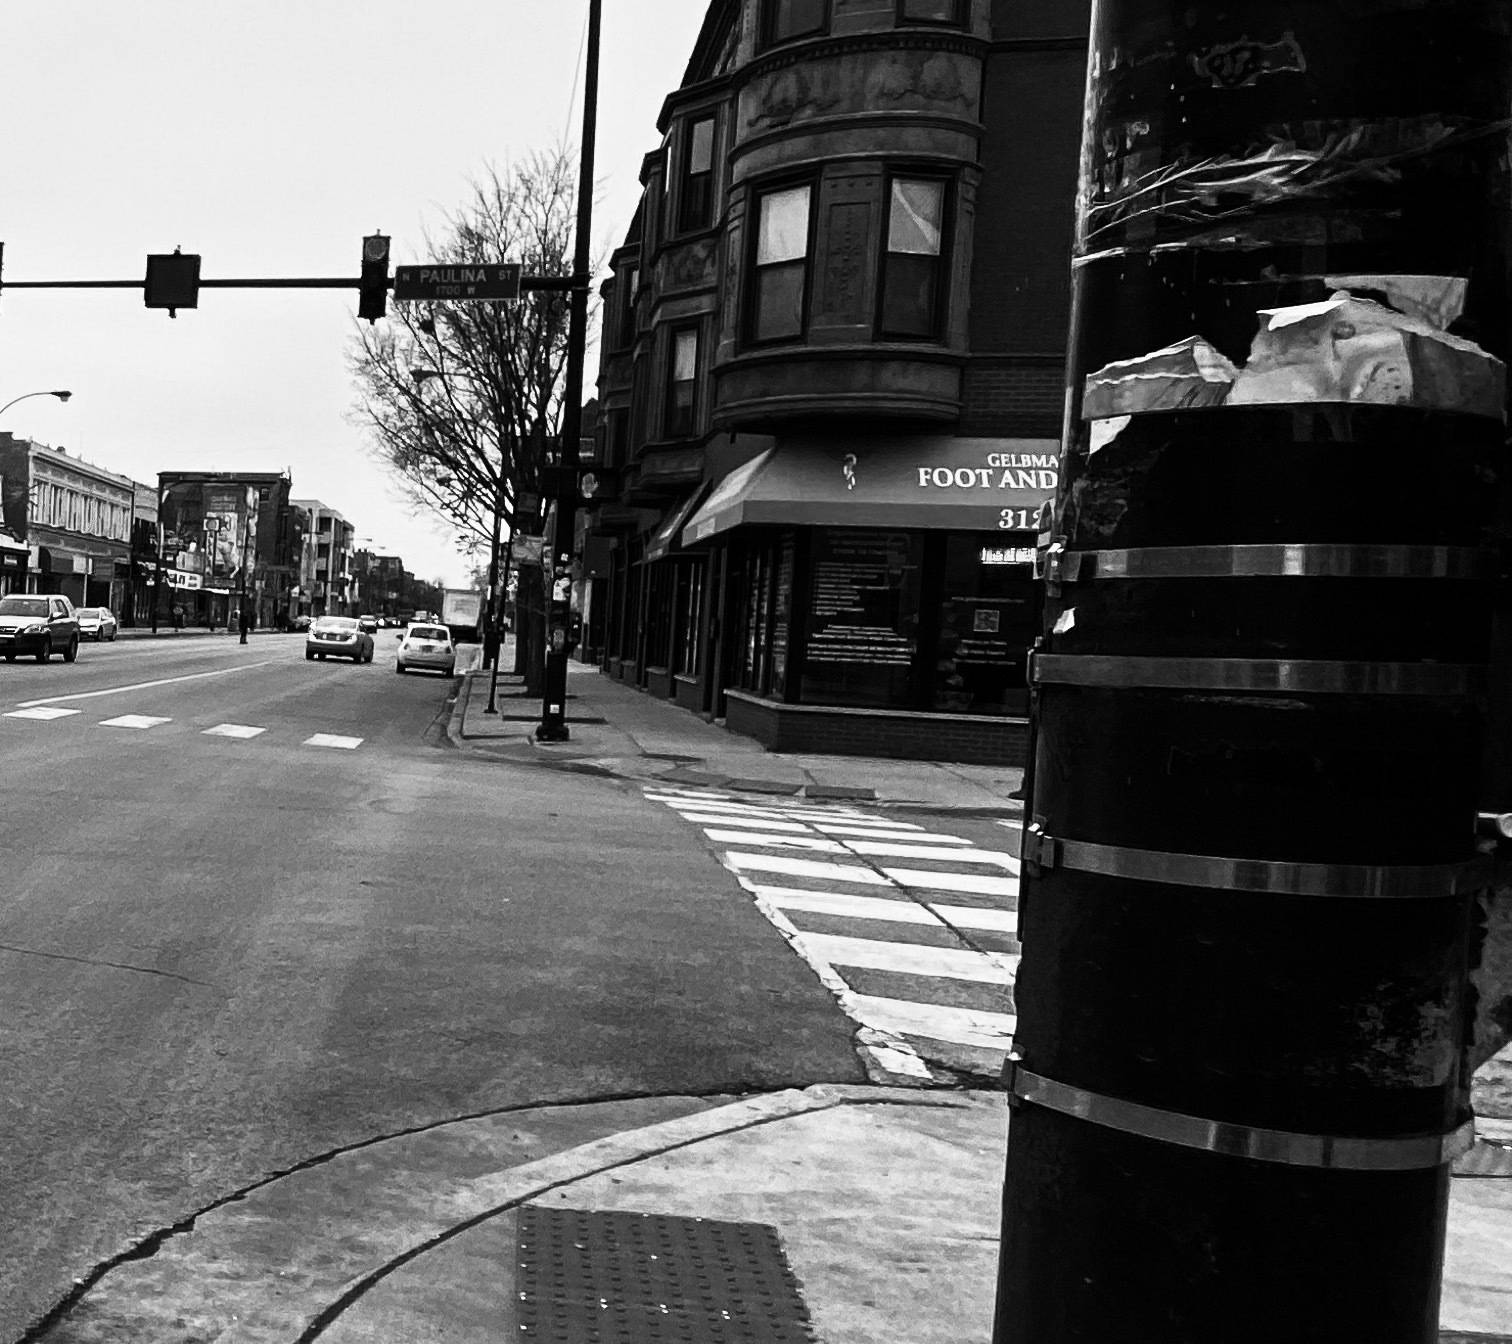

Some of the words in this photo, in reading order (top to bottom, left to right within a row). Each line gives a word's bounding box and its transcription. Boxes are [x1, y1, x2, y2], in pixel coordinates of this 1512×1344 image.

[402, 272, 411, 282] N
[419, 268, 487, 284] PAULINA
[498, 270, 513, 281] ST
[435, 285, 461, 296] 1700
[987, 452, 1059, 469] GELBMA
[917, 466, 994, 488] FOOT
[997, 468, 1058, 489] AND
